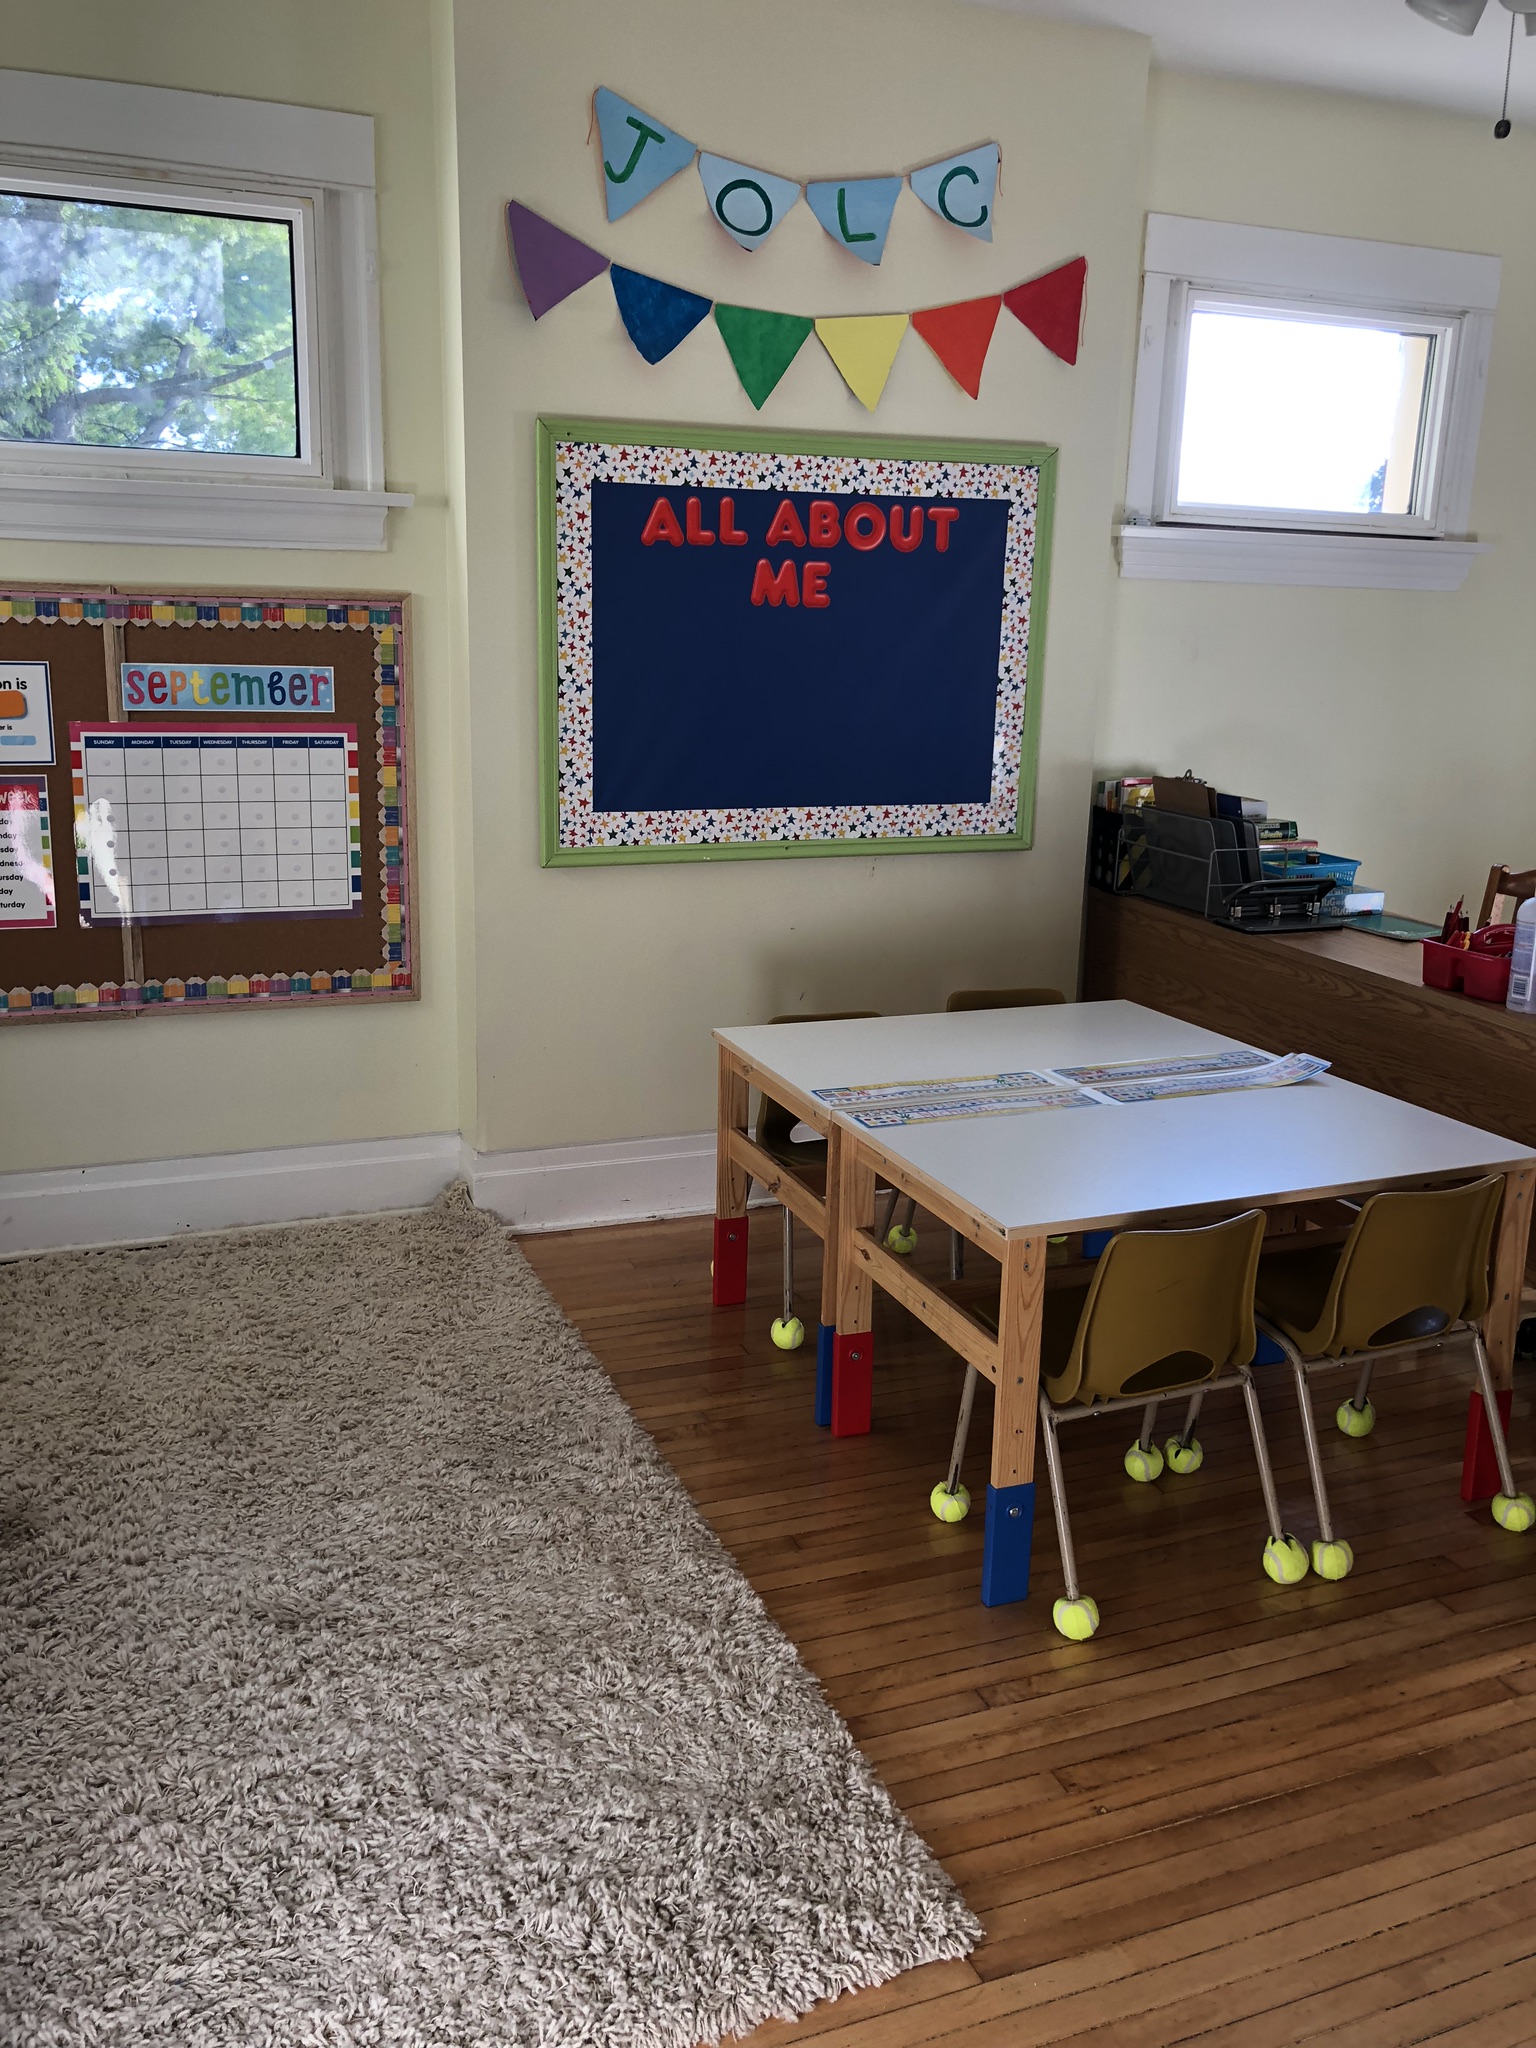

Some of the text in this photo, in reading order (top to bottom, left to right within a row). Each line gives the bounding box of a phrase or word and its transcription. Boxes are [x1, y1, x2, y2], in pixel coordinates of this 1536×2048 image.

[640, 496, 960, 553] ALL ABOUT
[750, 557, 832, 609] ME
[15, 677, 28, 691] is
[126, 669, 330, 707] september
